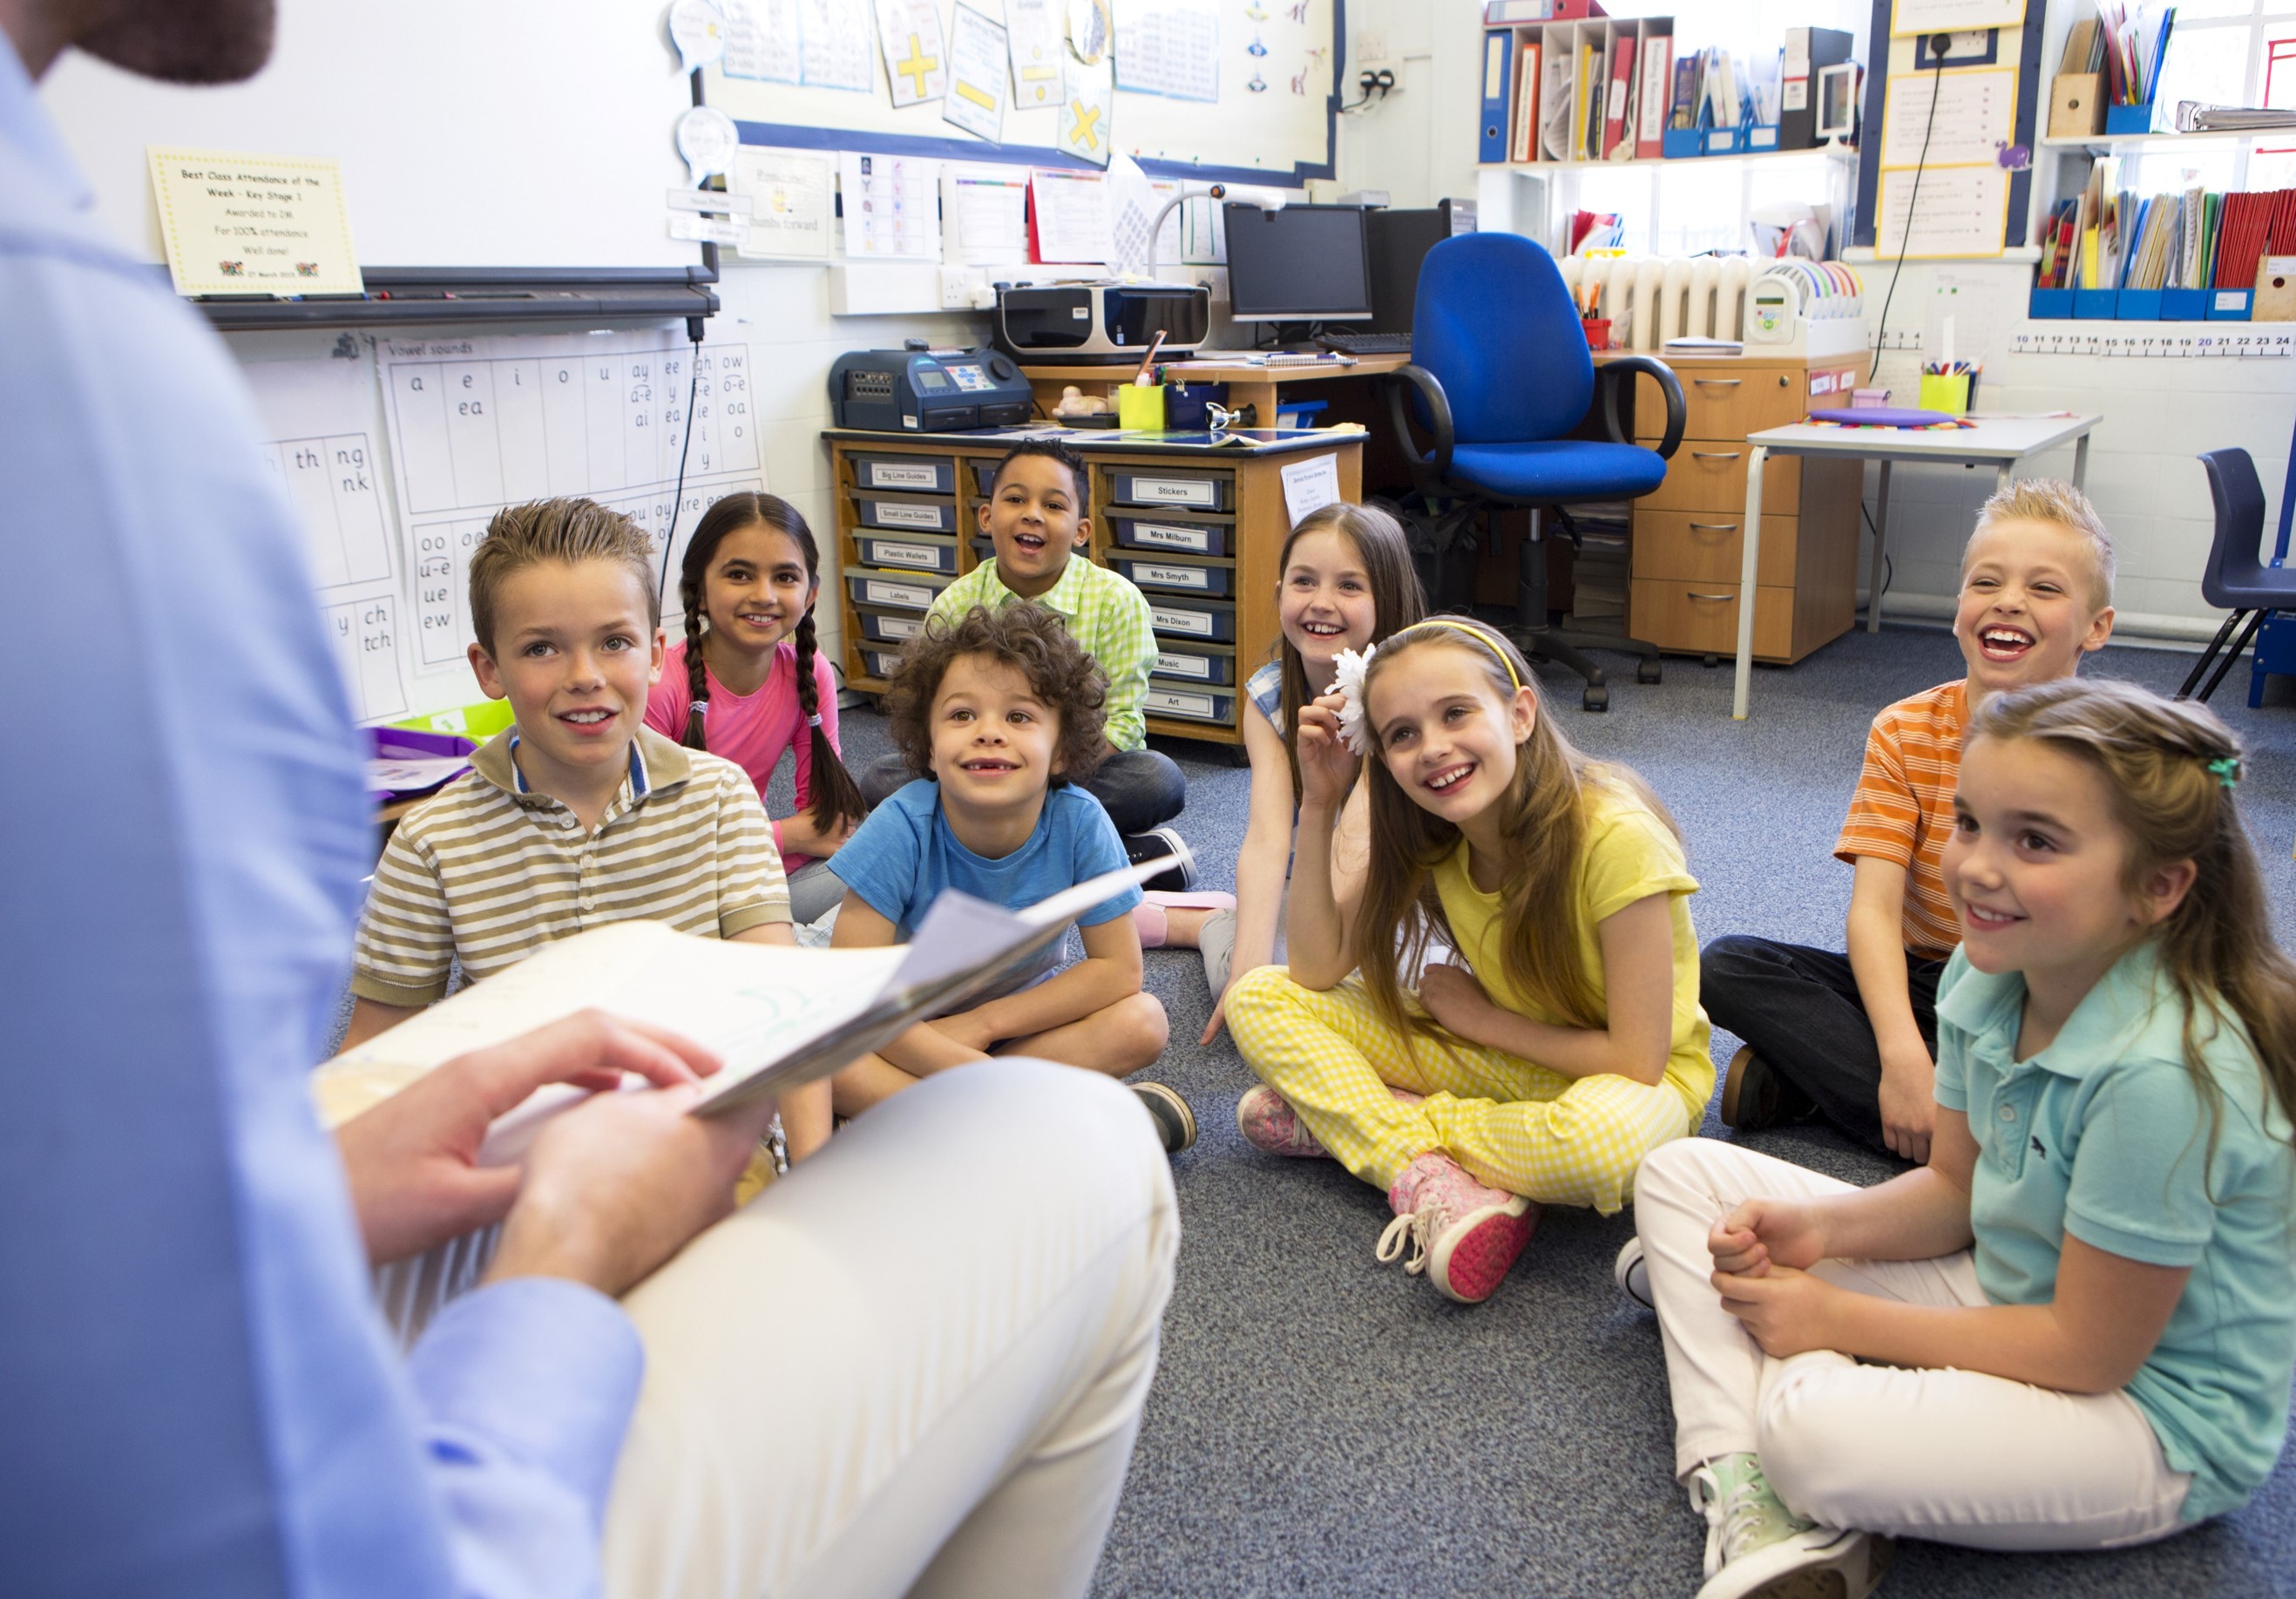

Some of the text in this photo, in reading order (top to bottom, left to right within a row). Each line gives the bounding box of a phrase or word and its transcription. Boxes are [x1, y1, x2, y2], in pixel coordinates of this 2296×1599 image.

[181, 169, 320, 186] Best Class Attendance of the
[207, 187, 234, 198] Week
[247, 190, 262, 200] Key
[268, 192, 294, 203] Stage
[226, 208, 265, 219] Awarded
[267, 210, 277, 219] to
[213, 225, 308, 238] For 100% attendance
[783, 217, 818, 231] forward
[242, 245, 263, 255] Well
[430, 341, 473, 356] sounds
[2016, 335, 2028, 343] 10
[2087, 335, 2098, 344] 14
[2105, 338, 2117, 347] 15
[2198, 338, 2212, 347] 20
[2256, 336, 2270, 345] 23
[2276, 336, 2290, 345] 24
[410, 376, 423, 390] a
[462, 374, 473, 389] e
[514, 368, 520, 385] i
[559, 369, 568, 383] o
[599, 367, 609, 381] u
[632, 364, 648, 382] ay
[665, 361, 680, 375] ee
[722, 356, 742, 369] ow
[668, 386, 676, 403] y
[458, 401, 483, 416] ea
[635, 402, 746, 427] ai ea ie oa
[669, 433, 677, 446] e
[735, 426, 742, 437] o
[296, 447, 319, 470] th
[336, 448, 364, 469] ng
[702, 452, 710, 470] y
[342, 471, 369, 492] nk
[882, 471, 891, 480] Big
[1158, 486, 1189, 496] Stickers
[421, 536, 445, 551] oo
[655, 503, 671, 520] oy
[681, 497, 700, 512] ire
[1150, 530, 1192, 543] Mrs Milburn
[884, 549, 928, 561] Plastic Wallets
[1151, 570, 1189, 582] Mrs Smyth
[424, 588, 447, 603] ue
[890, 591, 910, 600] Labels
[338, 603, 386, 637] y ch
[423, 613, 450, 629] ew
[1156, 615, 1190, 627] Mrs Dixon
[364, 629, 391, 652] tch
[1158, 658, 1180, 668] Music
[1168, 697, 1179, 706] Art
